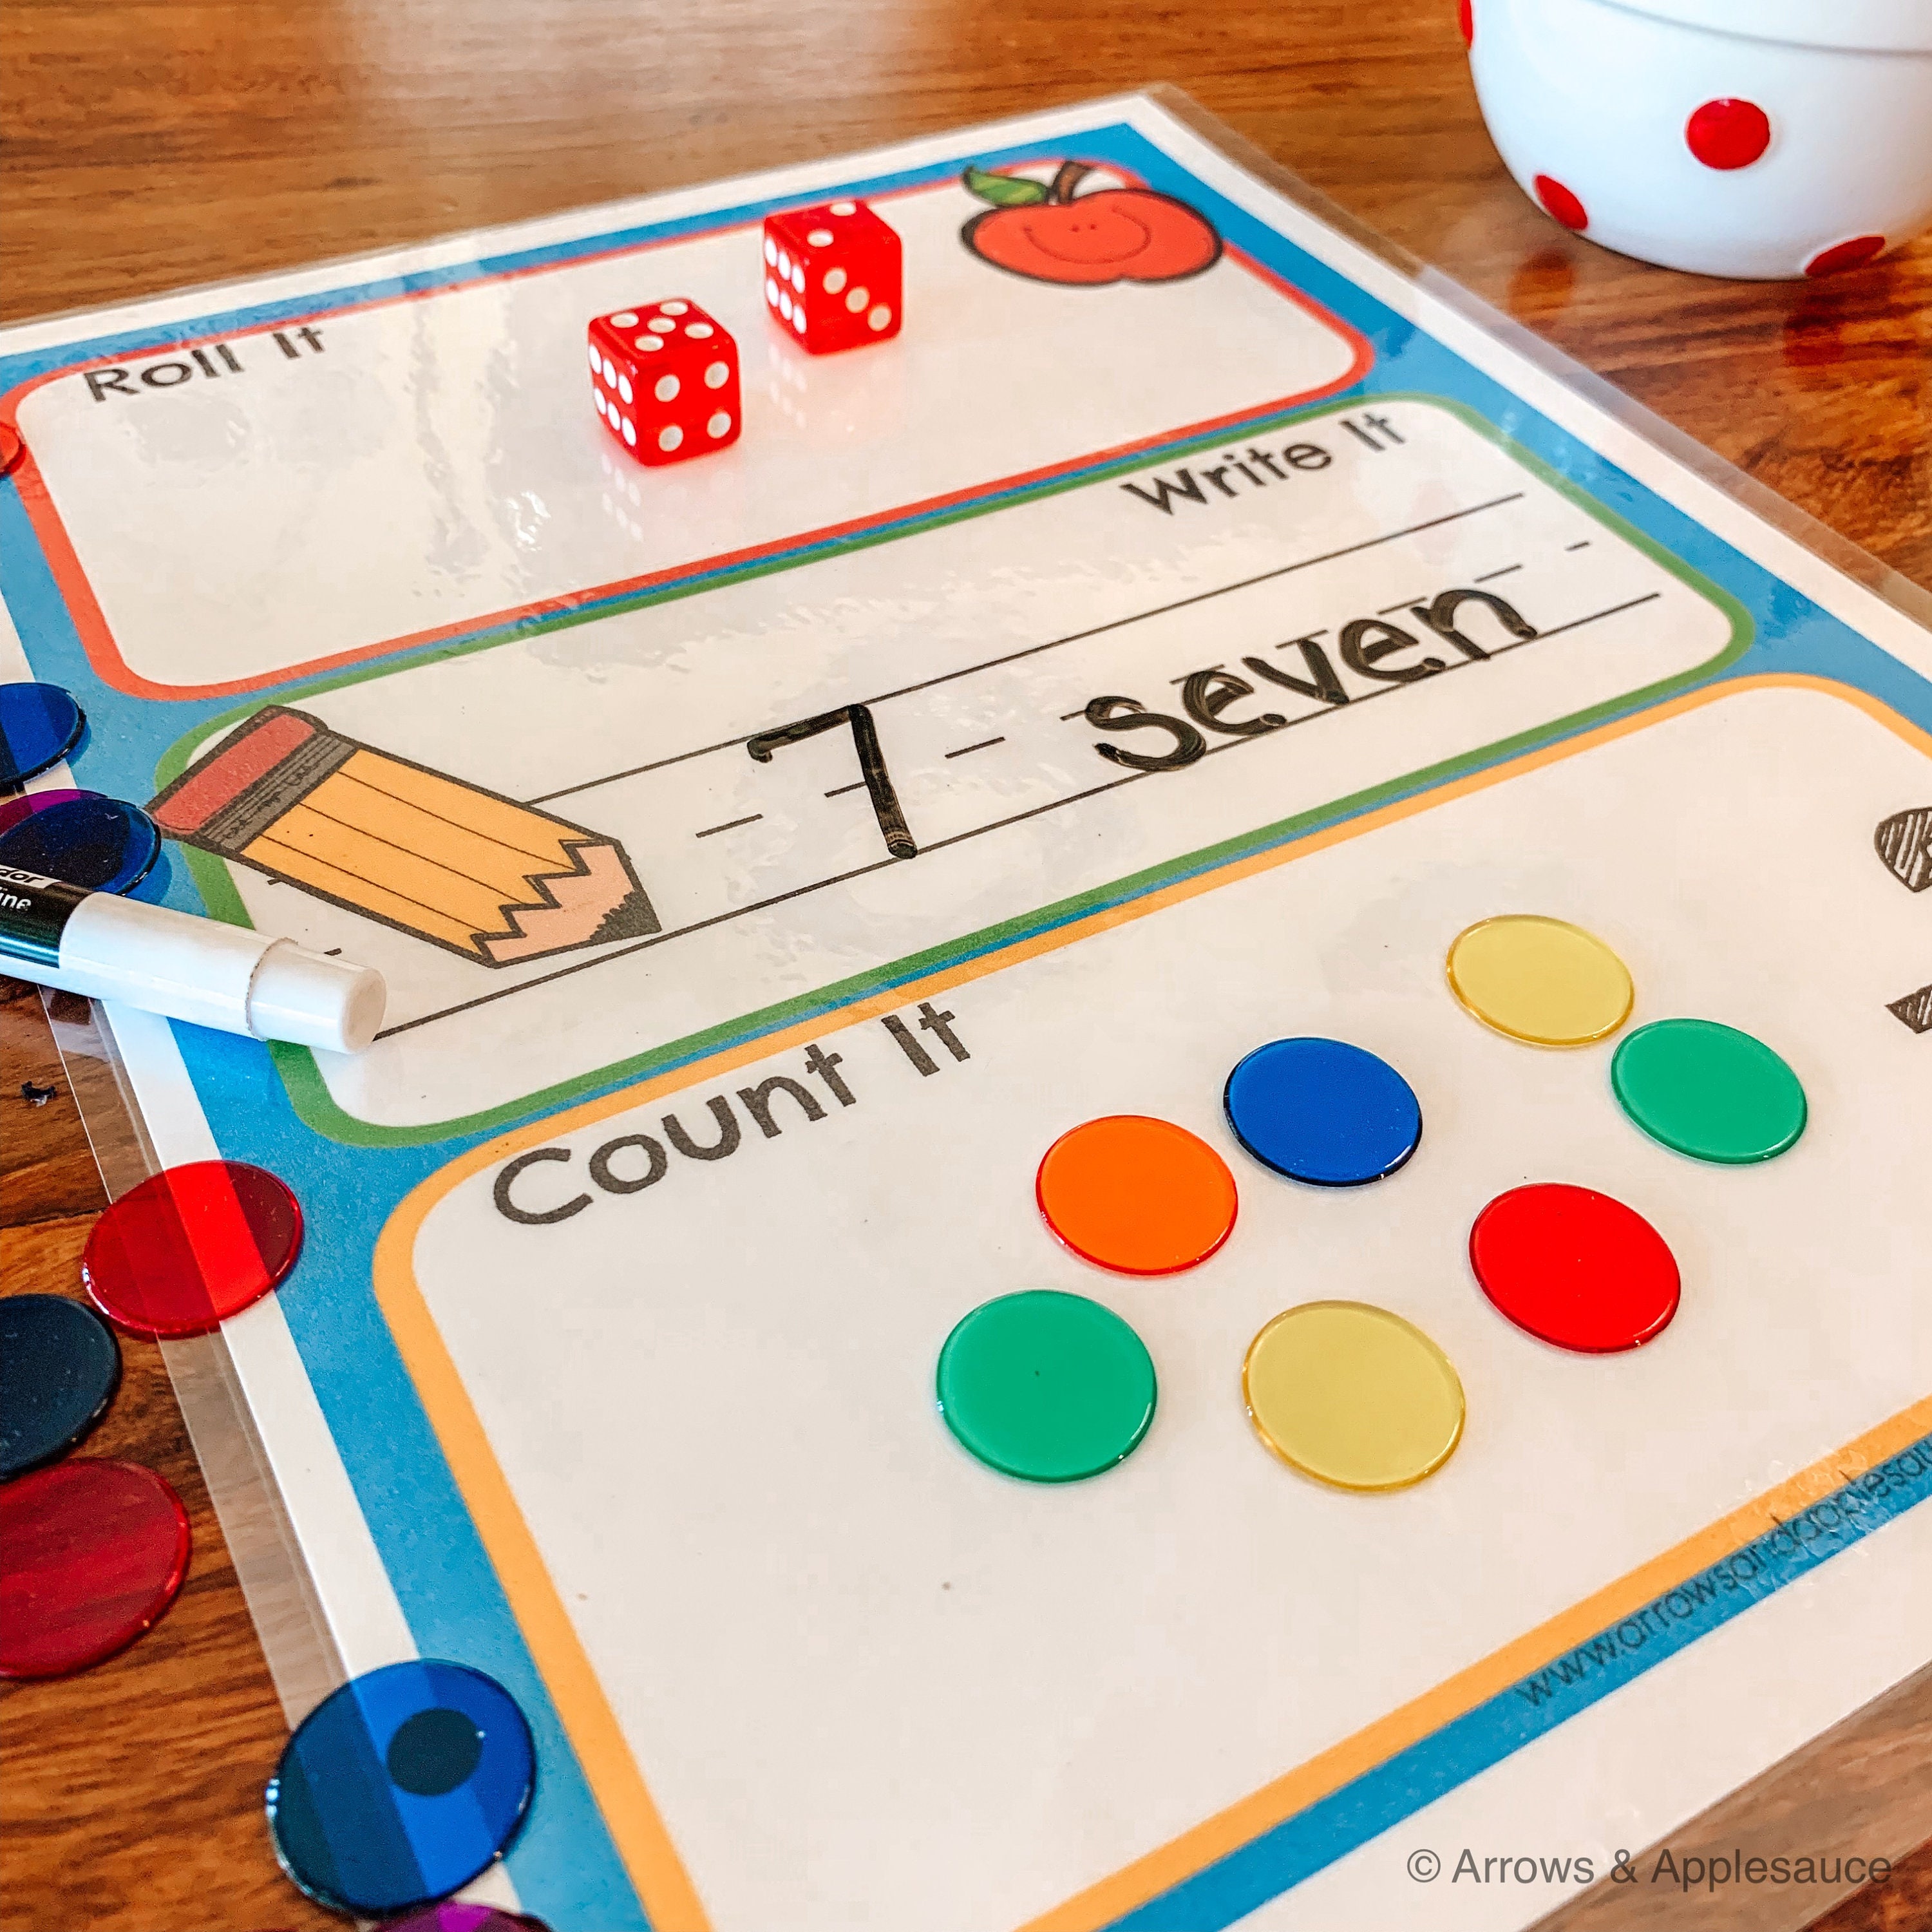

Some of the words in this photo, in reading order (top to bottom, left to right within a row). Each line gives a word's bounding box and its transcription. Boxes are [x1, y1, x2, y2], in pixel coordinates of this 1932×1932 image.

[83, 343, 245, 402] Roll
[272, 327, 325, 359] It
[1119, 443, 1333, 515] Write
[1340, 412, 1408, 452] It
[747, 703, 918, 859] 7
[1084, 589, 1539, 773] seven
[493, 1043, 857, 1225] Count
[881, 1002, 971, 1077] It
